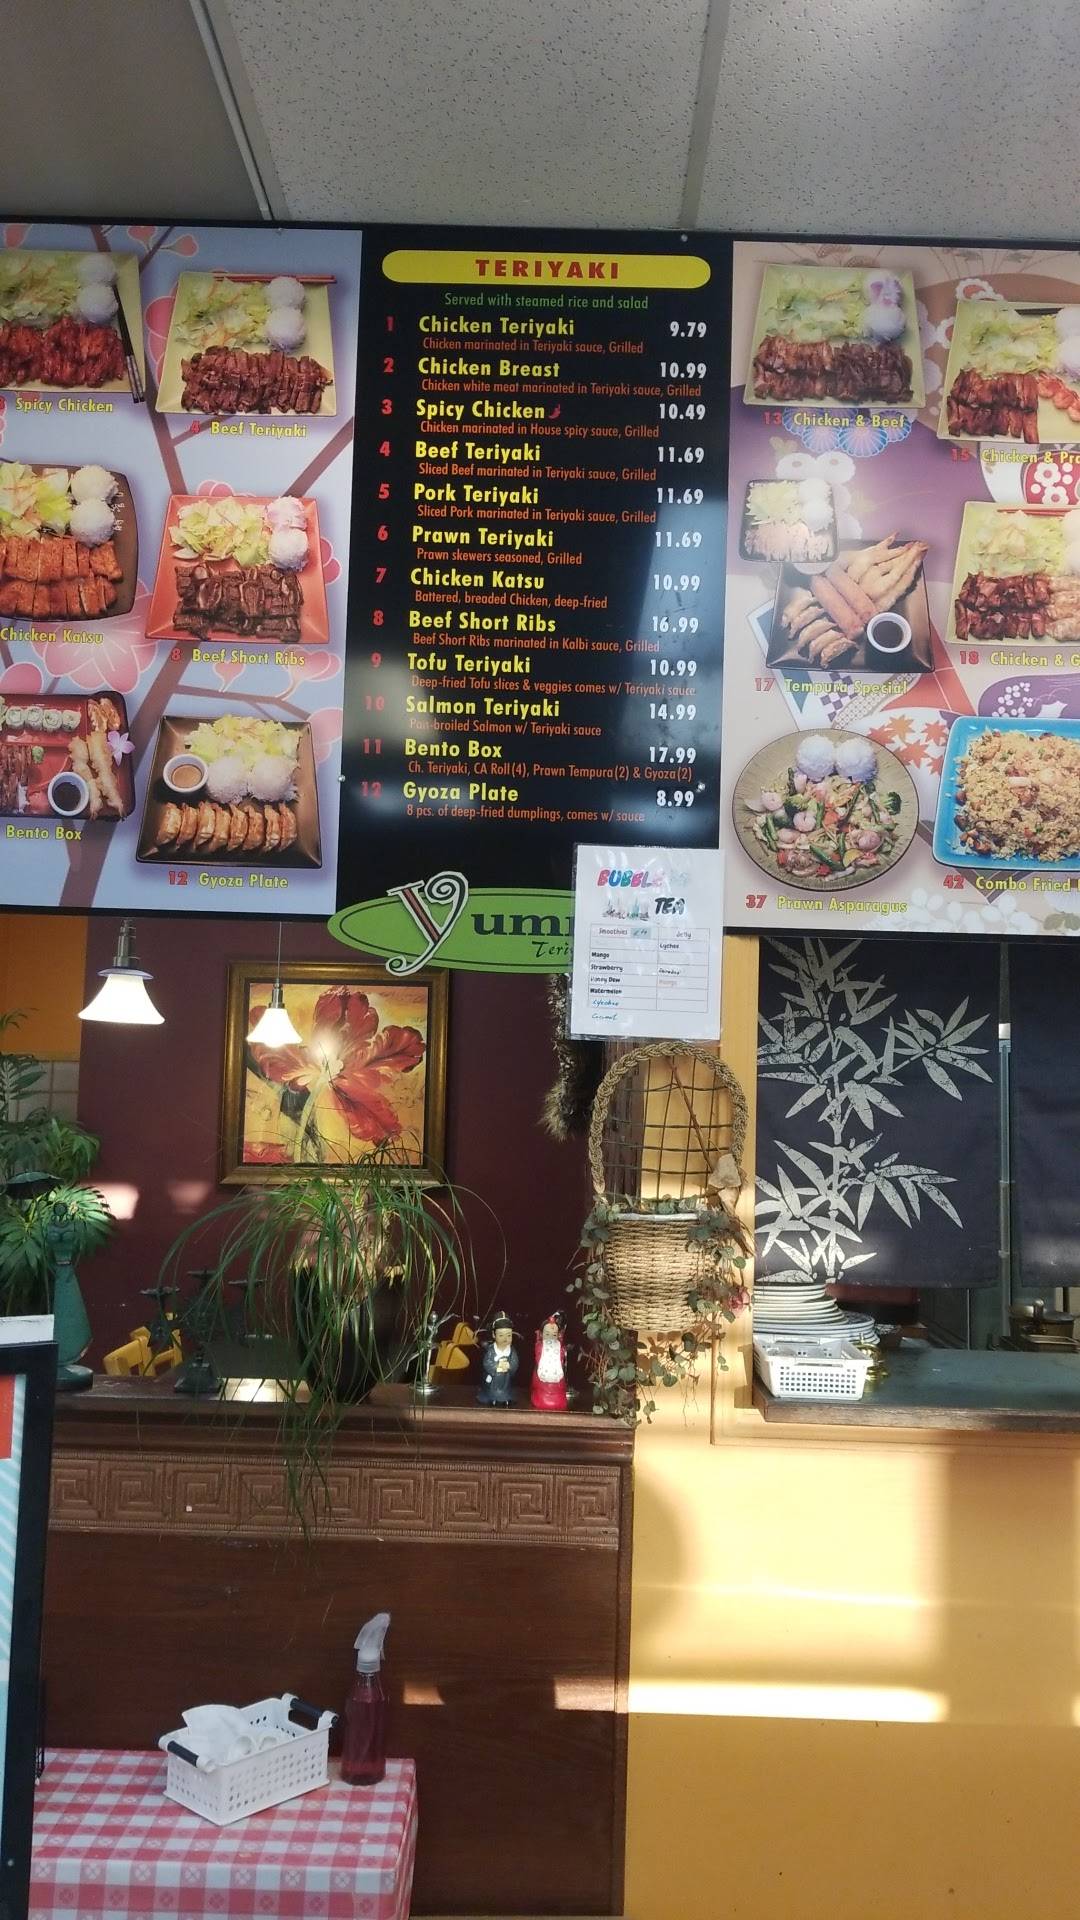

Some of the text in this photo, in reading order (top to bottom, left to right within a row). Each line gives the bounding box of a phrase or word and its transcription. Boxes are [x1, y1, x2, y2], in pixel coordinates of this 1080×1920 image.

[474, 260, 619, 280] TERIYAKI
[444, 292, 648, 309] Served with steamed rice and salad
[385, 315, 706, 337] 1 Chicken Teriyaki 9.79
[384, 357, 706, 378] 2 Chicken Breast 10.99
[421, 378, 460, 391] Chicken
[462, 379, 490, 391] white
[493, 382, 519, 392] meat
[521, 382, 576, 394] marinated
[575, 383, 587, 394] in
[590, 382, 630, 396] Teriyaki
[666, 383, 701, 396] Grilled
[16, 398, 113, 413] Spicy Chicken
[382, 399, 705, 420] 3 Spicy Chicken 10.49
[190, 420, 307, 438] 4 Beef Teriyaki
[420, 419, 459, 433] Chicken
[461, 422, 514, 434] marinated
[517, 423, 527, 434] in
[530, 423, 561, 435] House
[564, 424, 588, 438] spicy
[624, 424, 659, 437] Grilled
[764, 412, 905, 428] 13 Chicken & Beef
[378, 441, 704, 464] 4 Beef Teriyaki 11.69
[952, 448, 970, 462] 15
[982, 449, 1038, 463] Chicken
[1044, 452, 1053, 464] &
[418, 462, 448, 474] Sliced
[450, 463, 474, 475] Beef
[476, 464, 529, 477] marinated
[532, 466, 542, 478] in
[545, 466, 584, 480] Teriyaki
[621, 467, 656, 481] Grilled
[379, 482, 703, 505] 5 Pork Teriyaki 11.69
[417, 504, 447, 517] Sliced
[450, 505, 473, 518] Pork
[476, 507, 529, 519] marinated
[532, 508, 542, 520] in
[544, 508, 584, 522] Teriyaki
[621, 510, 656, 523] Grilled
[377, 525, 702, 548] 6 Prawn Teriyaki 11.69
[416, 547, 449, 560] Prawn
[451, 549, 491, 561] skewers
[546, 552, 582, 564] Grilled
[375, 566, 700, 591] 7 Chicken Katsu 10.99
[464, 591, 506, 604] breaded
[554, 594, 607, 609] deep-fried
[373, 610, 698, 633] 8 Beef Short Ribs 16.99
[0, 628, 104, 643] Chicken Katsu
[413, 632, 436, 644] Beef
[438, 632, 465, 646] Short
[469, 634, 490, 646] Ribs
[493, 636, 546, 648] marinated
[549, 638, 559, 649] in
[562, 637, 588, 650] Kalbi
[624, 639, 659, 652] Grilled
[172, 648, 305, 666] 8 Beef Short Ribs
[408, 652, 447, 672] Tofu
[455, 654, 530, 676] Teriyaki
[650, 659, 696, 676] 10.99
[960, 651, 979, 665] 18
[990, 652, 1048, 666] Chicken
[1055, 655, 1064, 666] &
[755, 678, 908, 696] 17 Tempura Special
[406, 696, 477, 714] Salmon
[483, 697, 559, 717] Teriyaki
[650, 703, 696, 720] 14.99
[363, 738, 696, 763] 11 Bento Box 17.99
[403, 780, 461, 801] Gyoza
[468, 782, 518, 801] Plate
[656, 790, 694, 807] 8.99
[6, 824, 82, 840] Bento Box
[168, 870, 288, 888] 12 Gyoza Plate
[944, 875, 965, 889] 42
[976, 876, 1028, 890] Combo
[1032, 877, 1071, 892] Fried
[655, 898, 685, 914] TEA
[746, 895, 908, 915] 37 Prawn Asparagus
[532, 941, 573, 958] Teri
[592, 952, 610, 960] Mango
[590, 964, 624, 972] Strawberry
